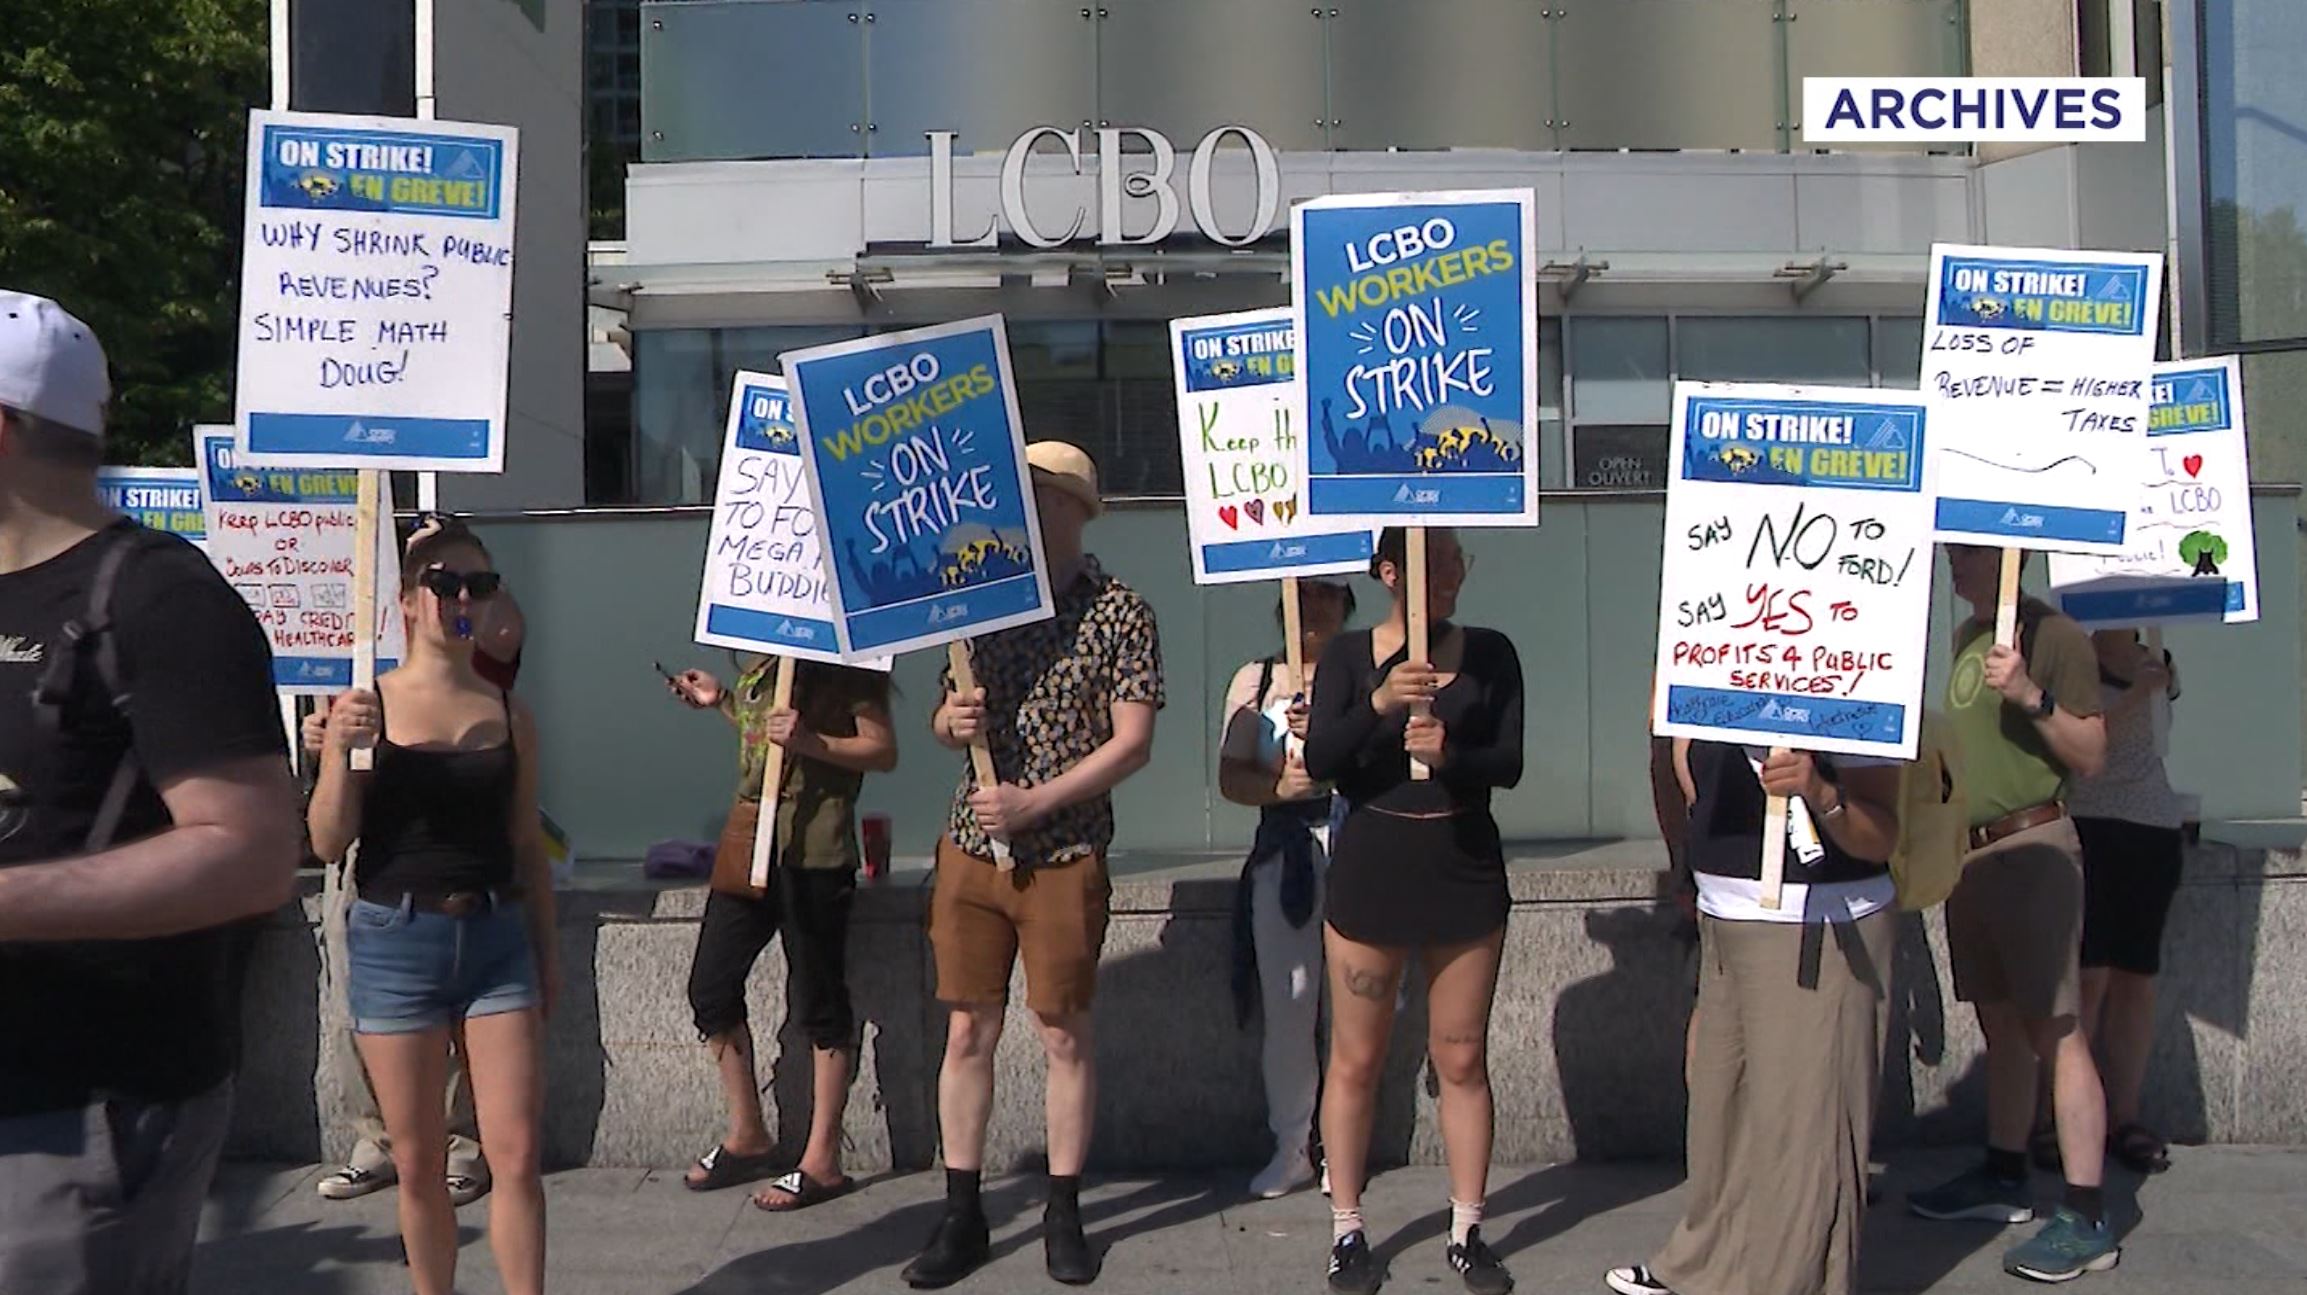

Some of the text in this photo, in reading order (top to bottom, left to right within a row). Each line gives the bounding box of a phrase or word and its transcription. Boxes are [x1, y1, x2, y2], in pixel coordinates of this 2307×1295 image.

[280, 140, 433, 173] ON STRIKE!
[350, 174, 383, 200] EN
[924, 125, 1280, 248] LCBO
[262, 221, 511, 266] WHY SHRINK PUBLIC
[1345, 217, 1456, 273] LCBO
[279, 265, 439, 300] REVENUES?
[1316, 239, 1515, 319] WORKERS
[1955, 269, 2088, 297] ON STRIKE!
[1384, 296, 1447, 355] ON
[2013, 298, 2043, 321] EN
[254, 313, 447, 343] SIMPLE MATH
[1930, 330, 2036, 355] LOSS OF
[1194, 339, 1223, 359] ON
[320, 349, 409, 388] DOUG!
[1247, 356, 1271, 376] EN
[843, 352, 940, 416] LCBO
[1345, 348, 1494, 419] STRIKE
[1934, 371, 2039, 400] REVENUE
[2070, 376, 2143, 399] HIGHER
[753, 397, 783, 420] ON
[823, 364, 995, 461] WORKERS
[2061, 407, 2138, 433] TAXES
[1198, 401, 1297, 453] Keep th
[1702, 412, 1854, 444] ON STRIKE!
[891, 426, 949, 485] ON
[1769, 447, 1803, 475] EN
[269, 474, 293, 494] EN
[730, 456, 804, 503] SAY
[1208, 462, 1288, 500] LCBO
[126, 488, 199, 509] STRIKE!
[865, 465, 997, 553] STRIKE
[2170, 486, 2222, 514] LCBO
[265, 511, 312, 529] LCBO
[725, 501, 817, 536] TO FO
[275, 537, 299, 552] OR
[718, 534, 803, 562] MEGA
[1687, 501, 1885, 570] SAY NO TO
[1838, 547, 1915, 587] FORD!
[1677, 583, 1858, 635] SAY YES TO
[1673, 641, 1893, 672] PROFITS 4 PUBLIC
[1729, 670, 1864, 697] SERVICES!
